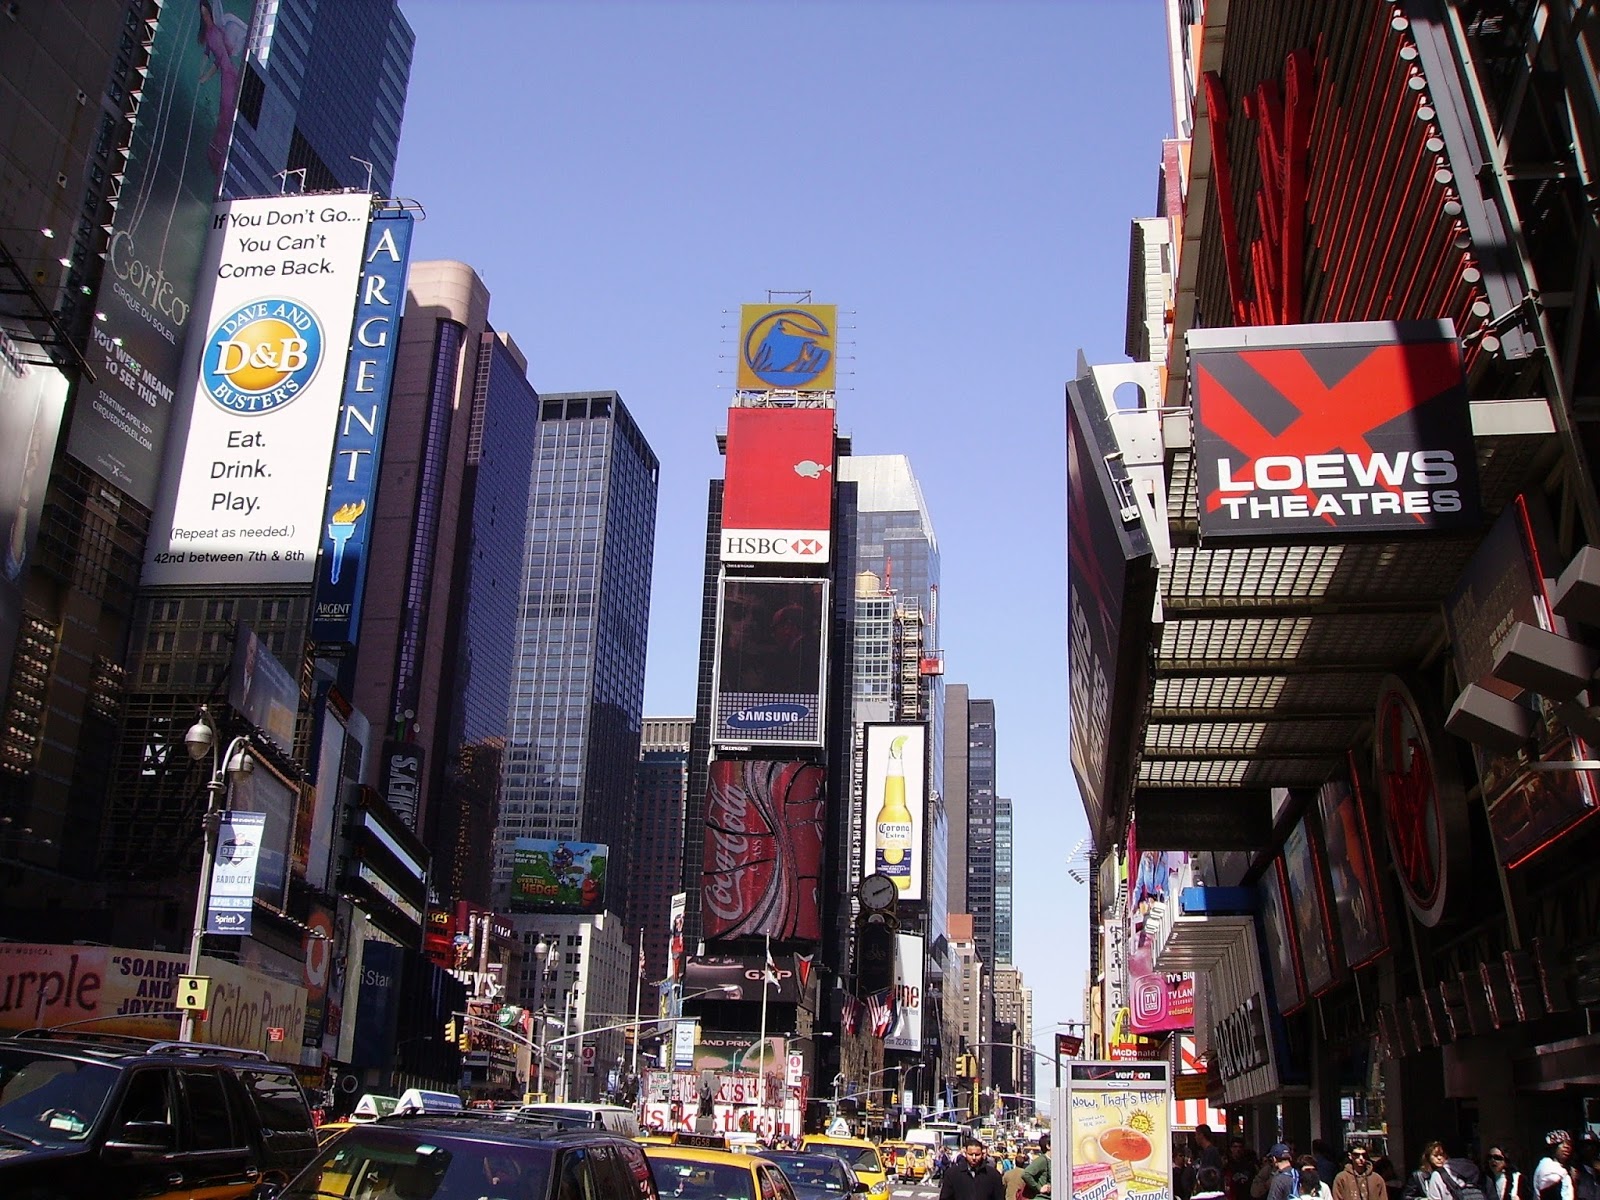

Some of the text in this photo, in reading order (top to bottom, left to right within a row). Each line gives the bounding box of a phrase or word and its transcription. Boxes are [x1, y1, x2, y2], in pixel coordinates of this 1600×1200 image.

[213, 208, 361, 230] If You Don't Go...
[238, 234, 326, 253] You Can't
[111, 230, 190, 326] Corteo
[218, 258, 335, 279] Come Back.
[113, 282, 176, 345] CIRQUE DU SOLEIL
[221, 303, 312, 336] DAVE AND
[93, 326, 175, 403] YOU WERE MEANT
[212, 337, 308, 375] D&B
[339, 227, 400, 482] ARGENT
[105, 355, 157, 408] TO SEE THIS
[212, 379, 300, 410] BUSTER'S
[99, 390, 126, 417] STARTING
[125, 411, 142, 429] APRIL
[226, 430, 267, 449] Eat.
[210, 459, 272, 479] Drink.
[1216, 449, 1458, 492] LOEWS
[211, 492, 261, 516] Play.
[1219, 488, 1462, 521] THEATRES
[169, 525, 296, 542] (Repeat as needed.)
[726, 537, 788, 555] HSBC
[154, 550, 305, 564] 42nd between 7th & 8th
[315, 601, 352, 614] ARGENT
[737, 710, 799, 723] SAMSUNG
[878, 823, 910, 834] Corona
[216, 875, 252, 884] RADIO CITY
[521, 883, 559, 896] HEDGE
[215, 914, 236, 925] Sprint
[136, 979, 173, 999] AND
[1111, 1048, 1160, 1057] McDonald's
[1115, 1071, 1151, 1080] verizon
[1101, 1092, 1138, 1107] That's
[690, 1136, 711, 1147] 8G58
[1072, 1176, 1117, 1200] Snapple
